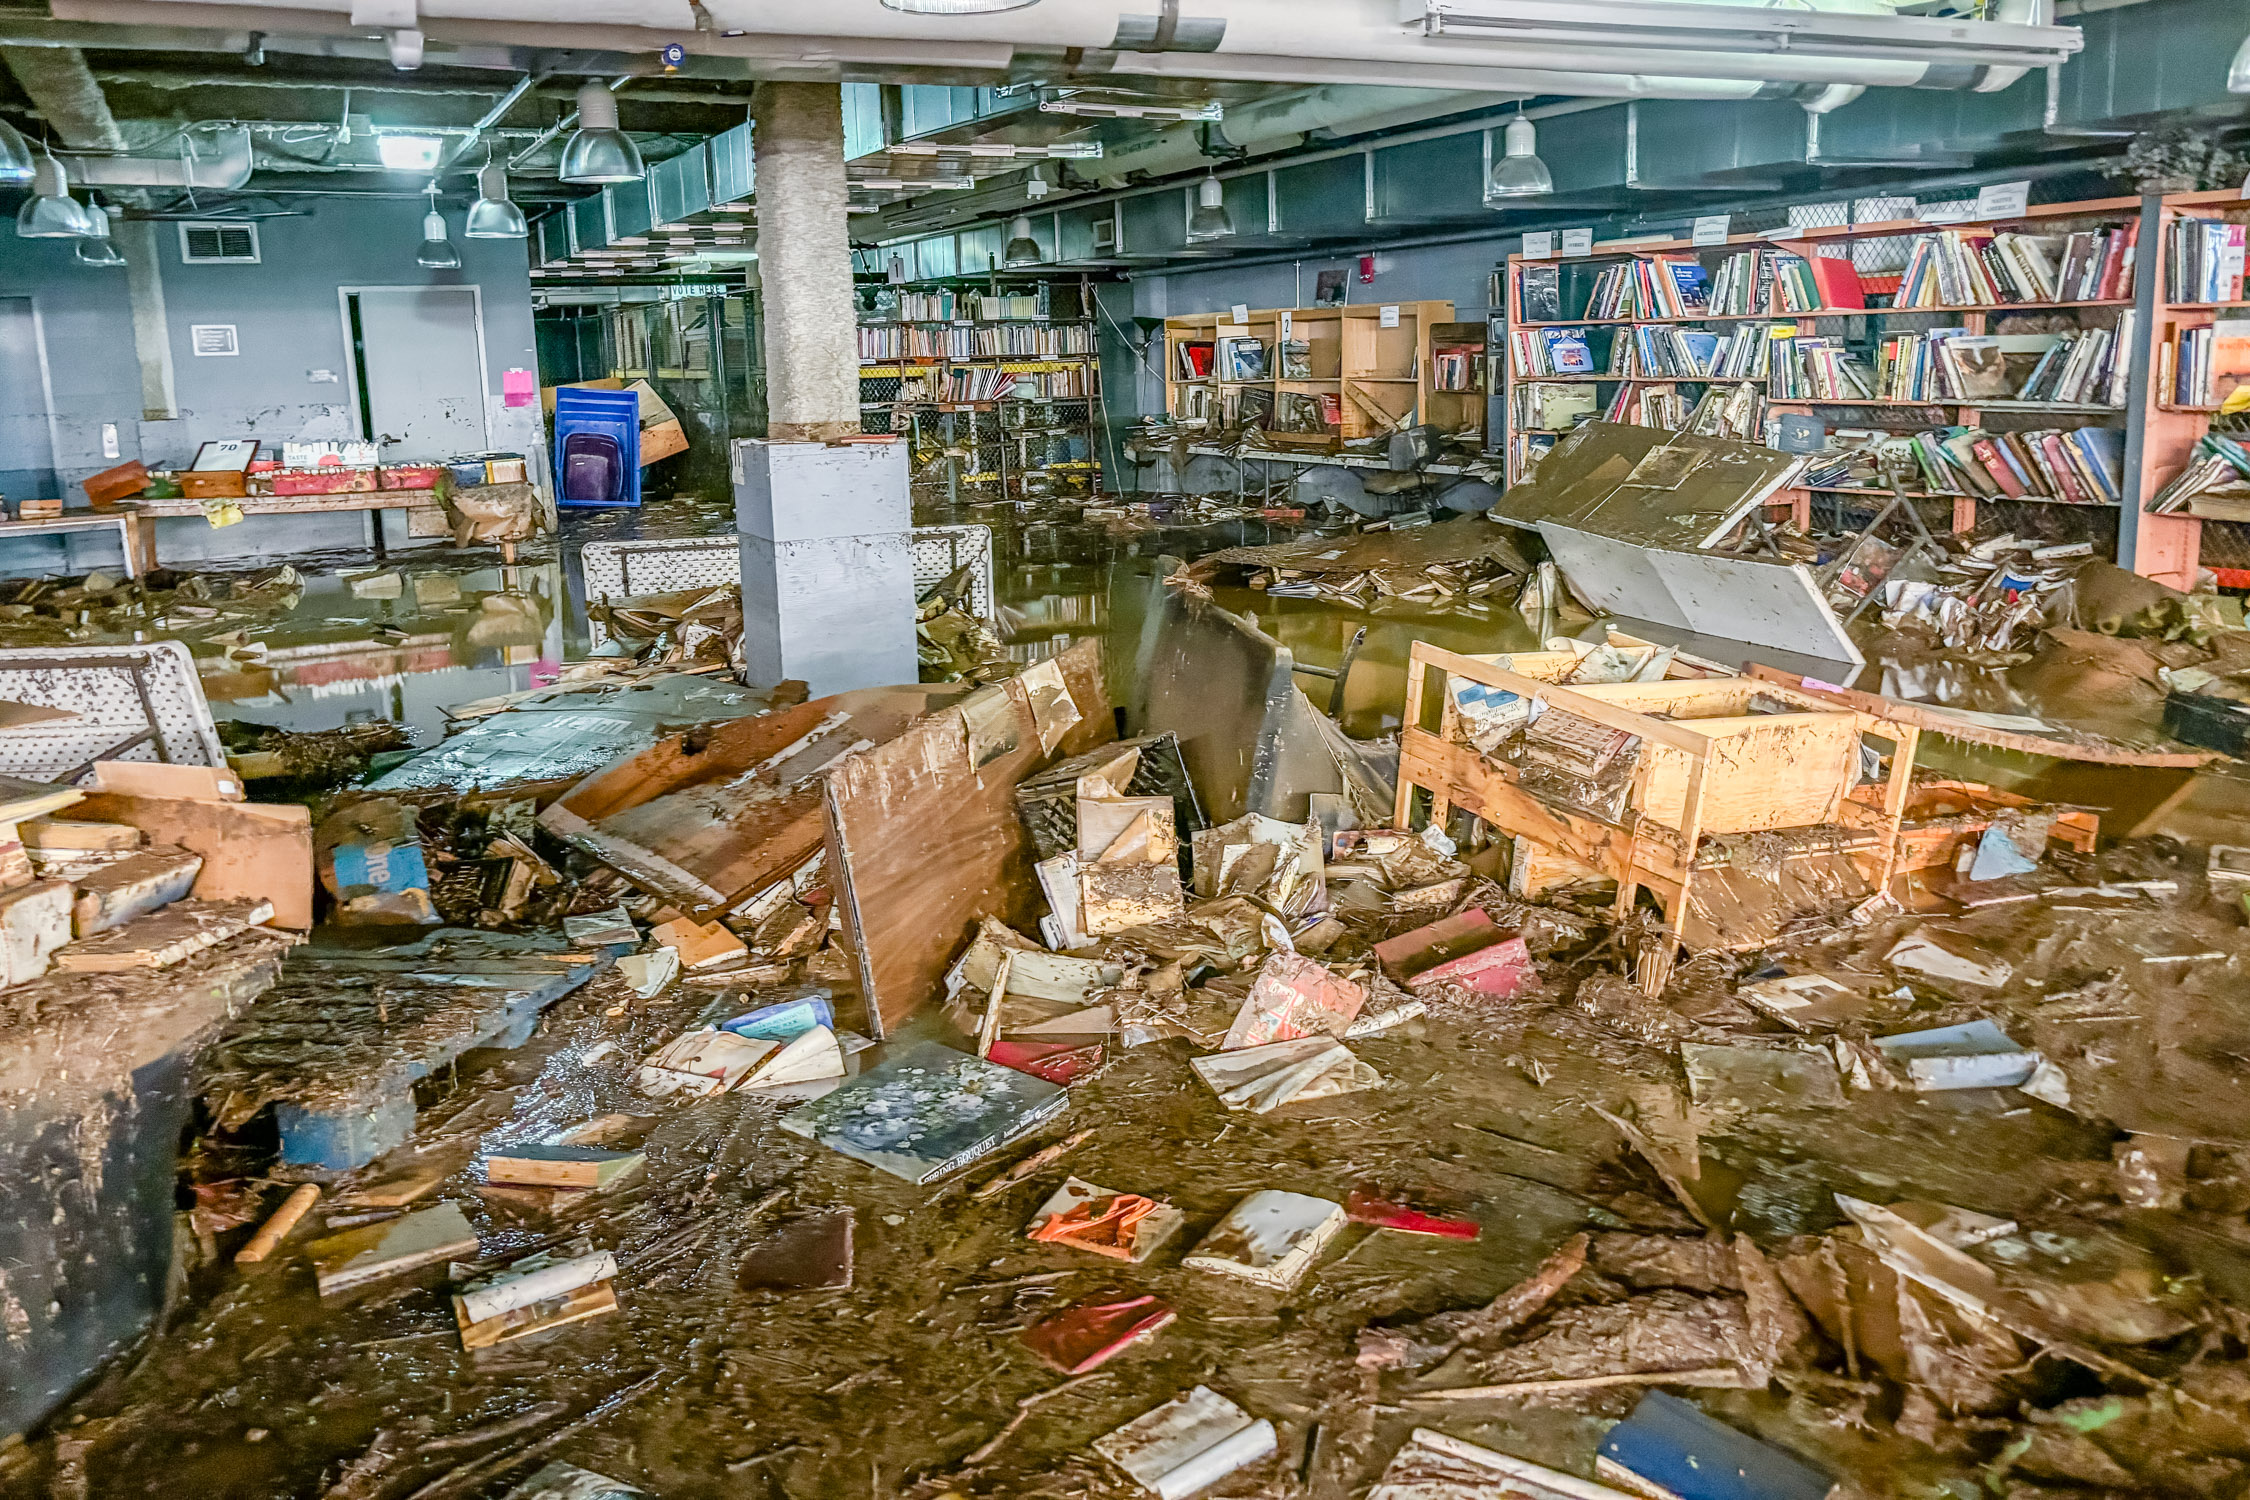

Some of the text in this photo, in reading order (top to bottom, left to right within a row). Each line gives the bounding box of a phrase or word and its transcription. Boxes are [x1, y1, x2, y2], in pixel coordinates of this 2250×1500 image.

[894, 262, 899, 278] 1
[671, 284, 720, 295] VOTE HERE
[1285, 318, 1290, 333] 2
[955, 1135, 996, 1166] BOUQUET
